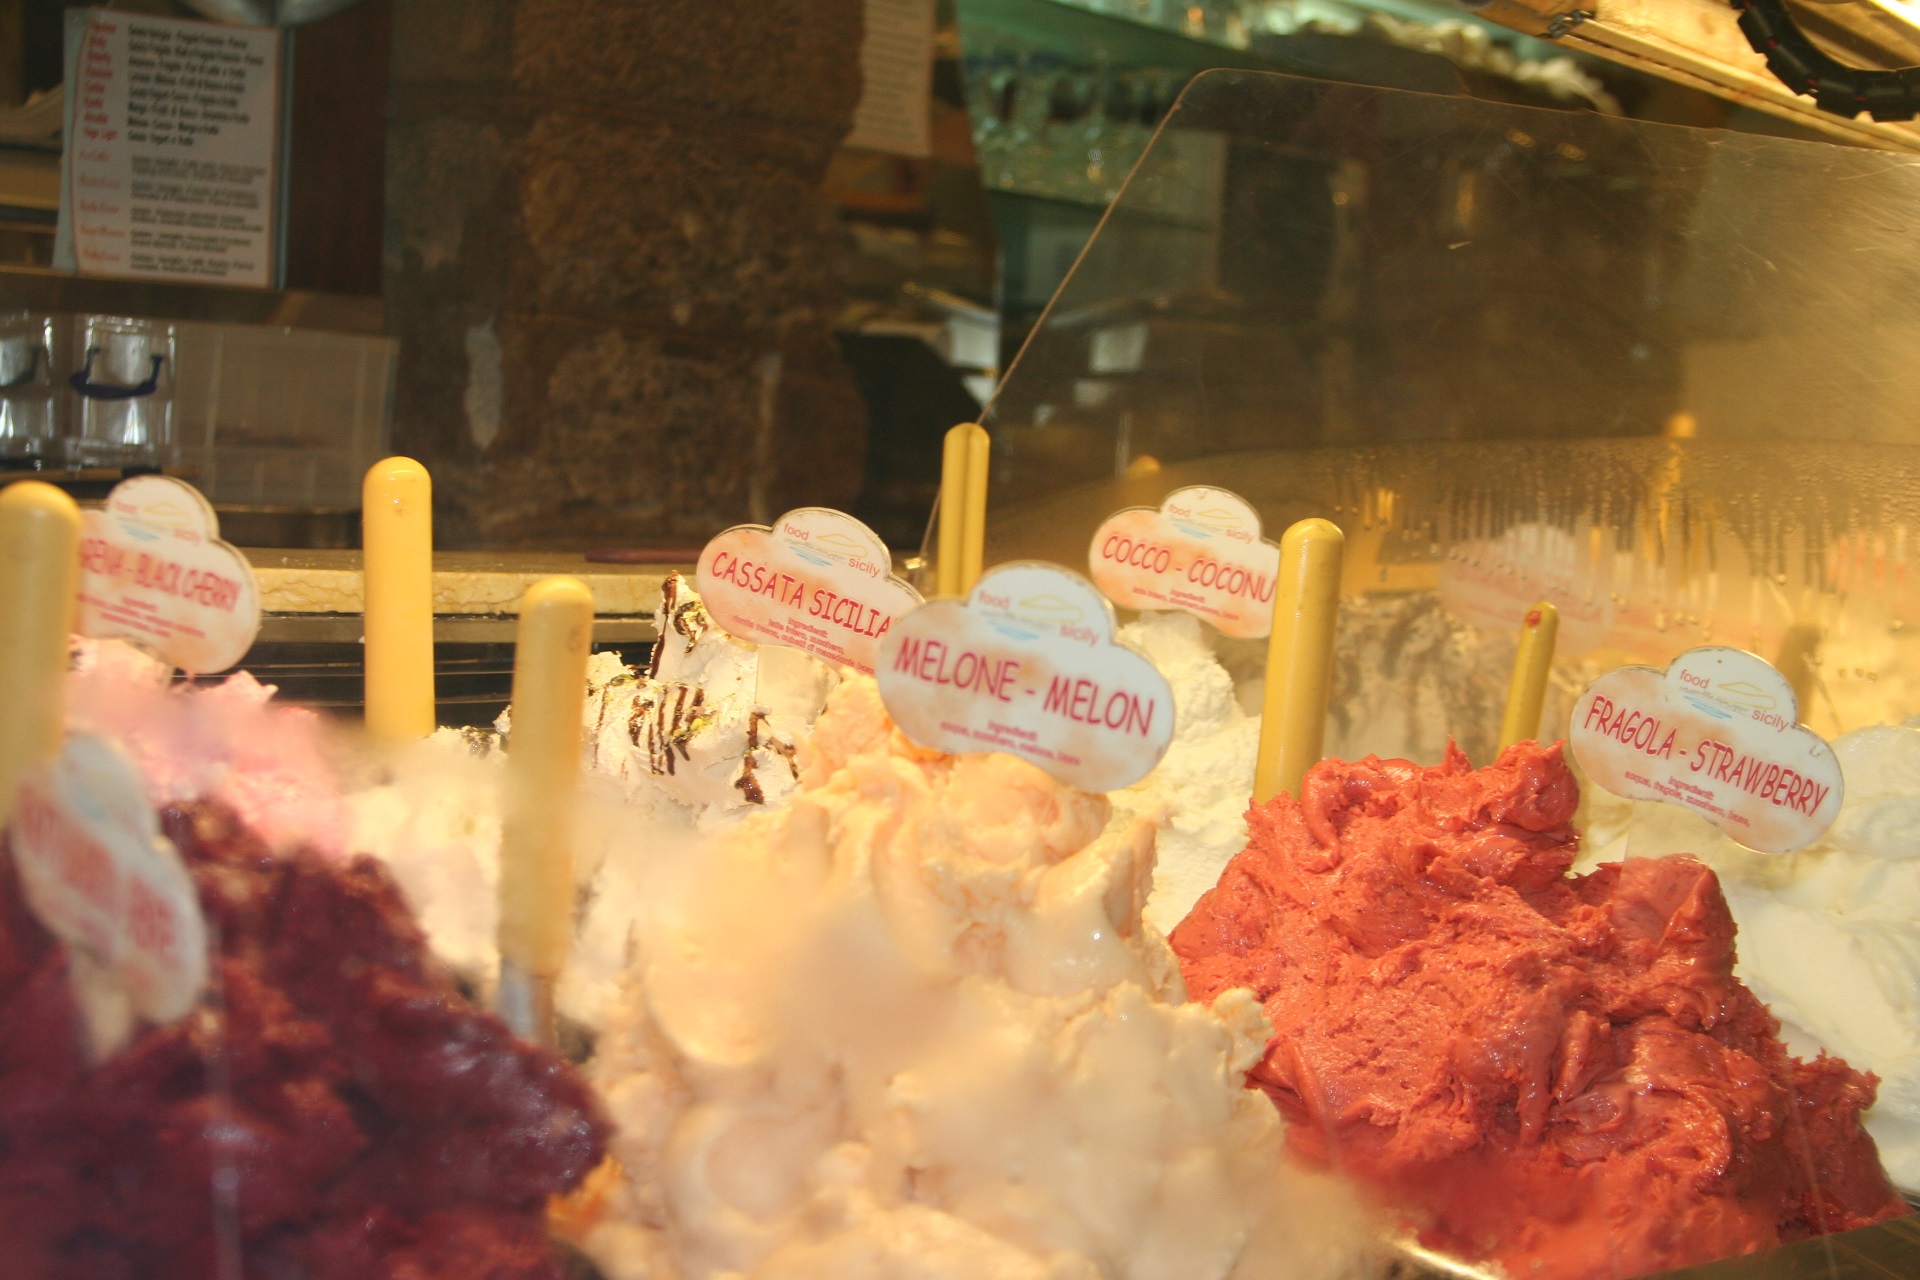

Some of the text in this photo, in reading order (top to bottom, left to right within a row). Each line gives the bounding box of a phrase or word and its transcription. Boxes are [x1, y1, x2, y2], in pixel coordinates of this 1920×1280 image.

[1168, 503, 1190, 518] food
[783, 522, 810, 540] food
[1225, 528, 1255, 544] sicily
[848, 556, 881, 578] sicily
[1102, 534, 1171, 574] COCCO
[1188, 559, 1277, 603] COCONU
[711, 551, 892, 639] CASSATA SICILIA
[978, 590, 1010, 610] food
[1059, 623, 1100, 647] sicily
[893, 636, 1021, 703] MELONE
[1042, 673, 1155, 738] MELON
[1679, 669, 1710, 690] food
[1752, 707, 1791, 734] sicily
[1583, 695, 1678, 760] FRAGOLA
[1690, 740, 1830, 818] STRAWBERRY
